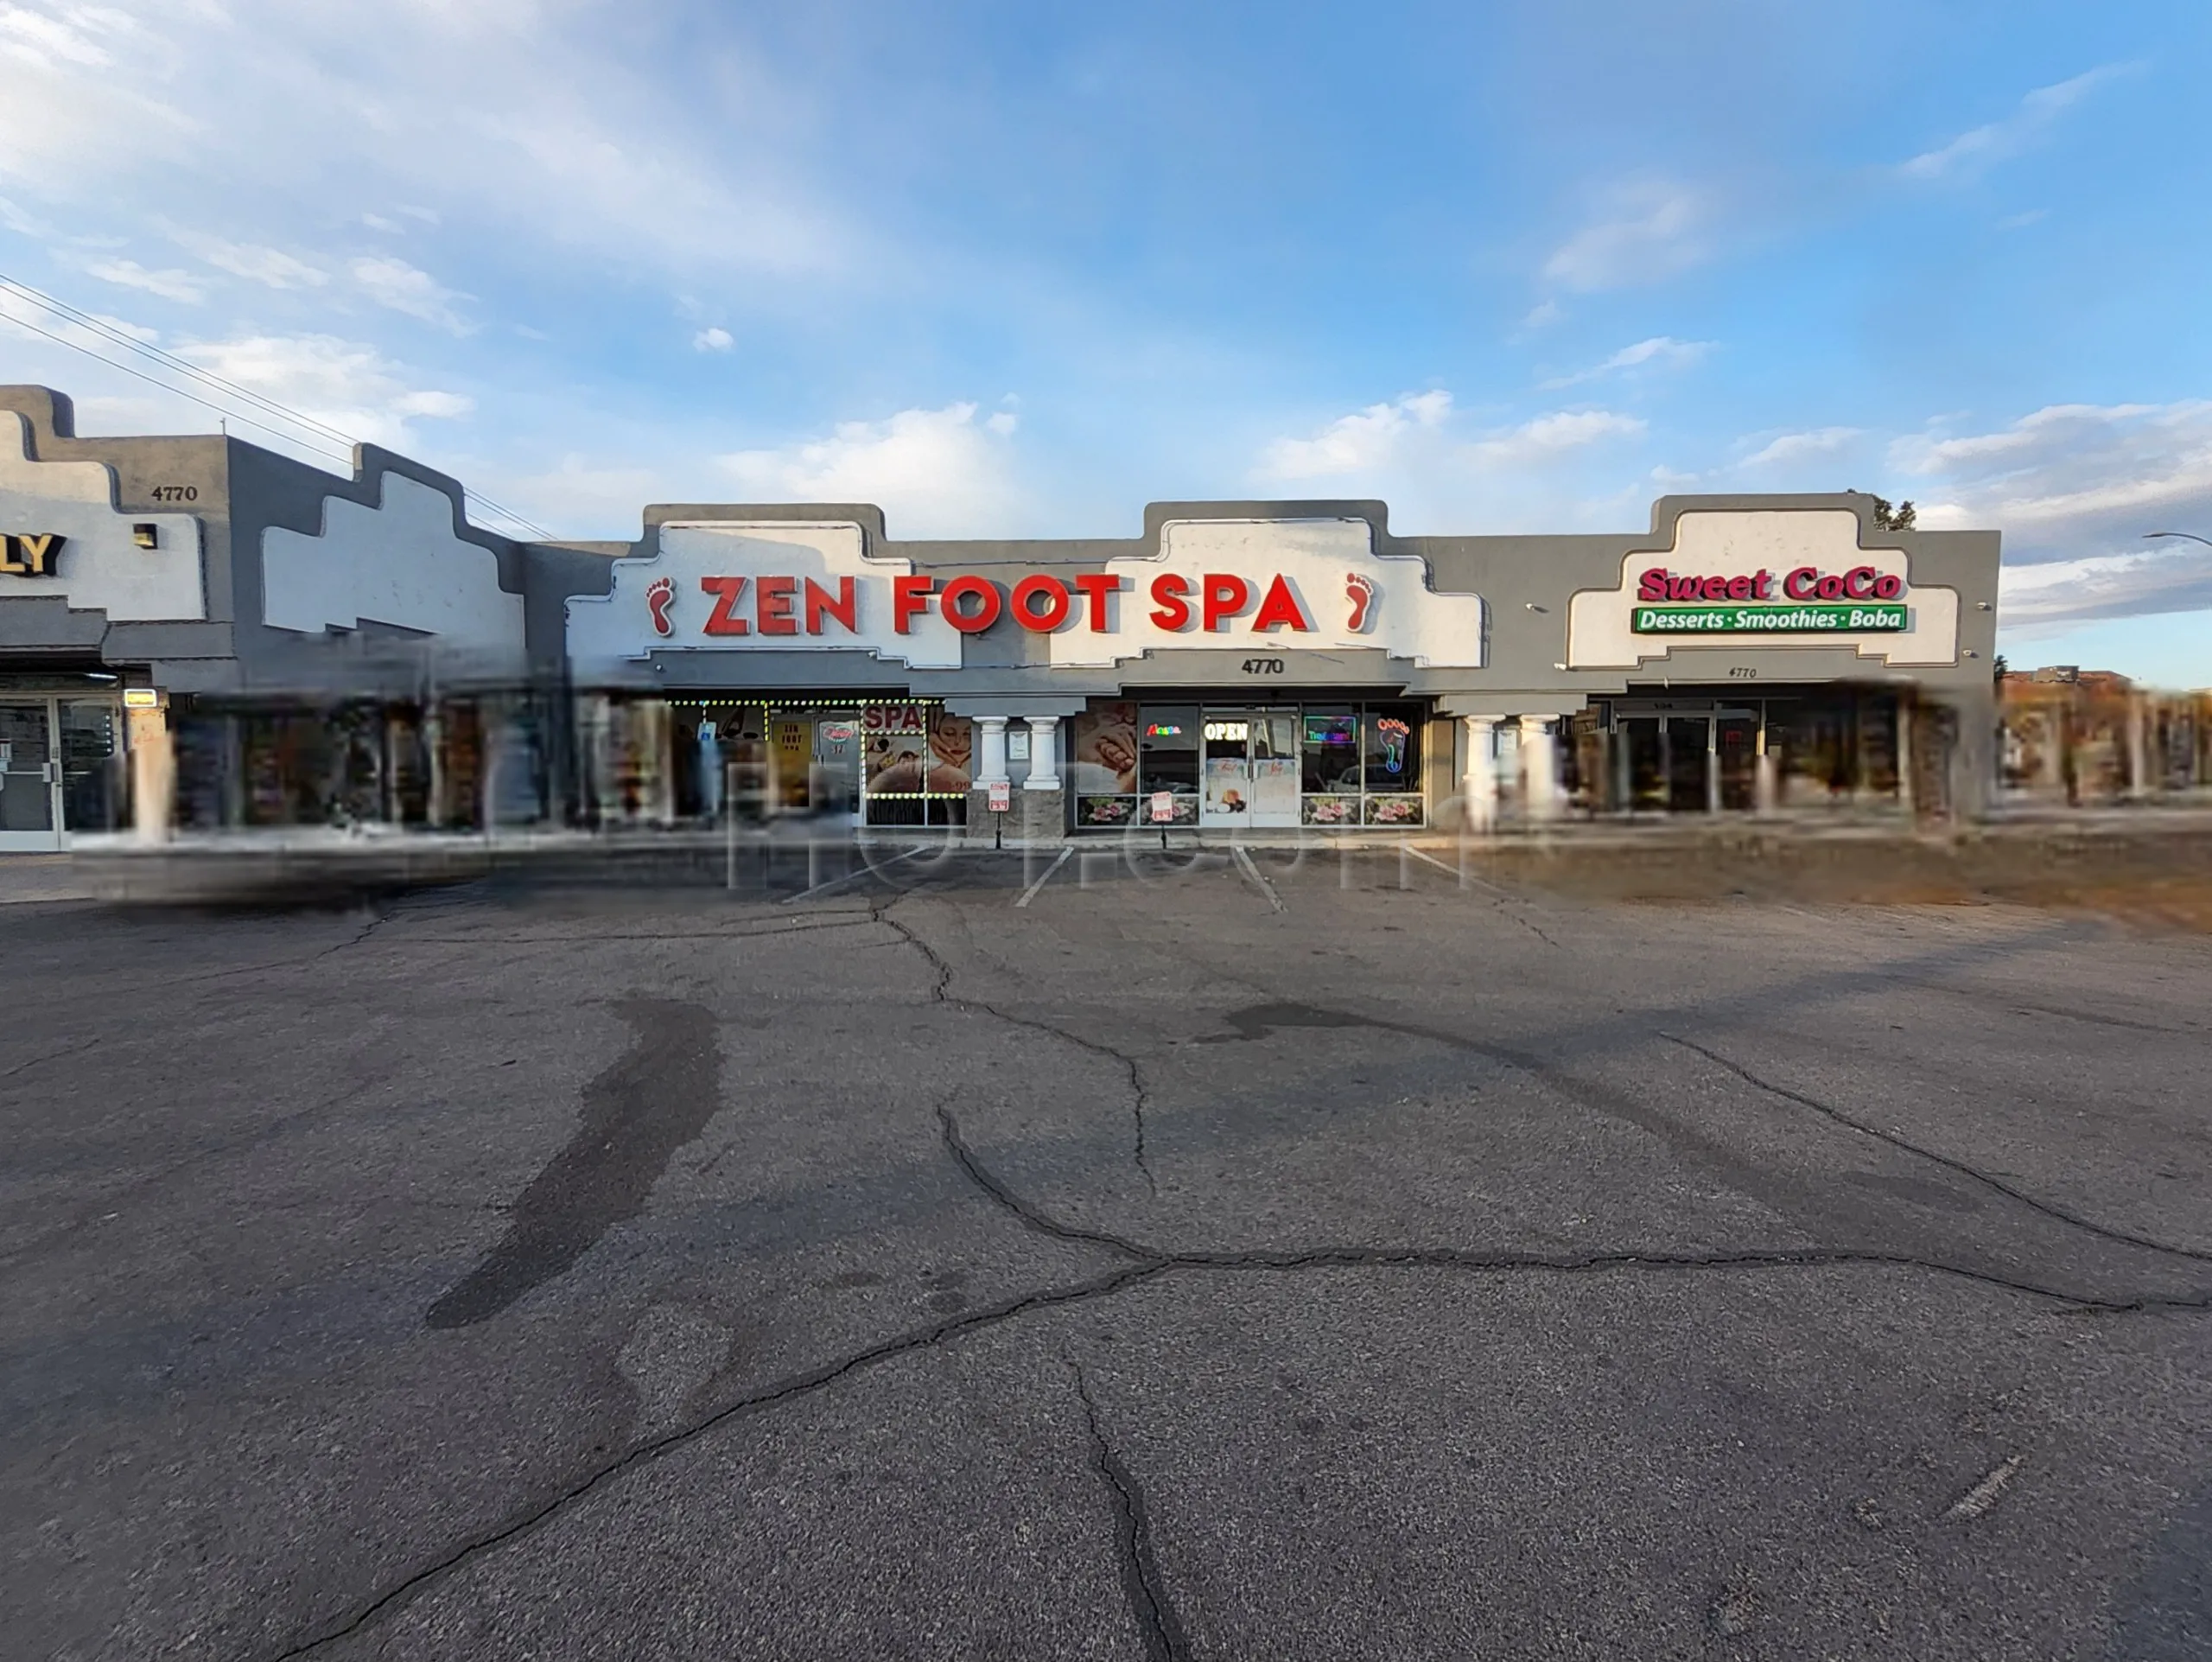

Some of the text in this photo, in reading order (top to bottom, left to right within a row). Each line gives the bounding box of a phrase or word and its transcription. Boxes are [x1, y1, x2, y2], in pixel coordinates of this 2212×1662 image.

[151, 486, 198, 501] 4770
[1638, 566, 1903, 602] Sweet CoCo
[700, 572, 1310, 635] ZEN FOOT SPA
[1640, 608, 1902, 629] Desserts Smoothies Boba
[1241, 658, 1285, 674] 4770
[1729, 666, 1758, 678] 4770
[865, 705, 923, 729] SPA
[1205, 723, 1249, 741] OPEN
